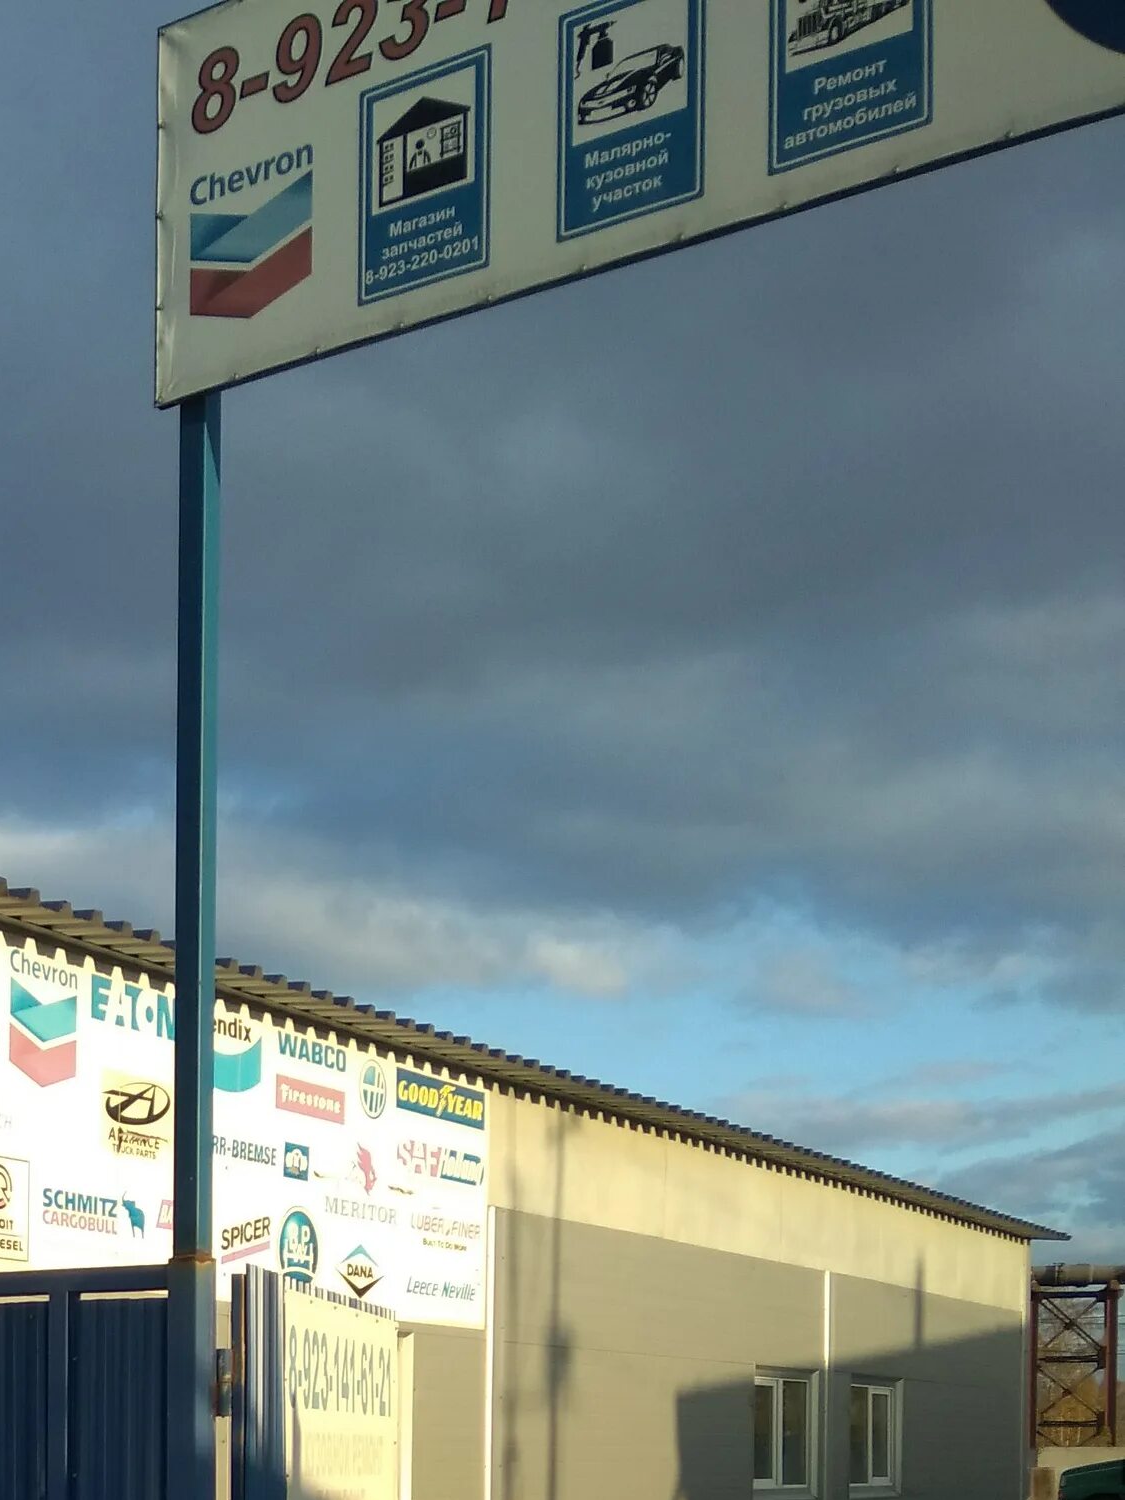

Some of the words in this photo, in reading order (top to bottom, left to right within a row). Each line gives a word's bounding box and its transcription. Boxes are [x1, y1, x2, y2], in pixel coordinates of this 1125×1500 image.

[190, 0, 510, 134] 8-923-
[812, 58, 887, 95] Ремонт
[802, 77, 898, 122] грузовых
[783, 93, 917, 151] автомобилей
[583, 131, 672, 169] Малярно-
[585, 149, 669, 190] кузовной
[189, 143, 314, 206] Chevron
[591, 174, 662, 212] участок
[380, 221, 463, 261] запчастей
[388, 205, 456, 239] Магазин
[364, 236, 480, 286] 8-923-220-0201
[9, 948, 79, 990] Chevron
[278, 1031, 347, 1073] WABCO
[42, 1188, 118, 1218] SCHMITZ
[42, 1209, 118, 1236] CARGOBULL
[325, 1195, 398, 1226] MERITOR
[221, 1216, 271, 1252] SPICER
[347, 1264, 374, 1280] DANA
[406, 1275, 439, 1297] Leece
[441, 1281, 476, 1301] Neville
[288, 1324, 391, 1418] 8-923-141-61-21
